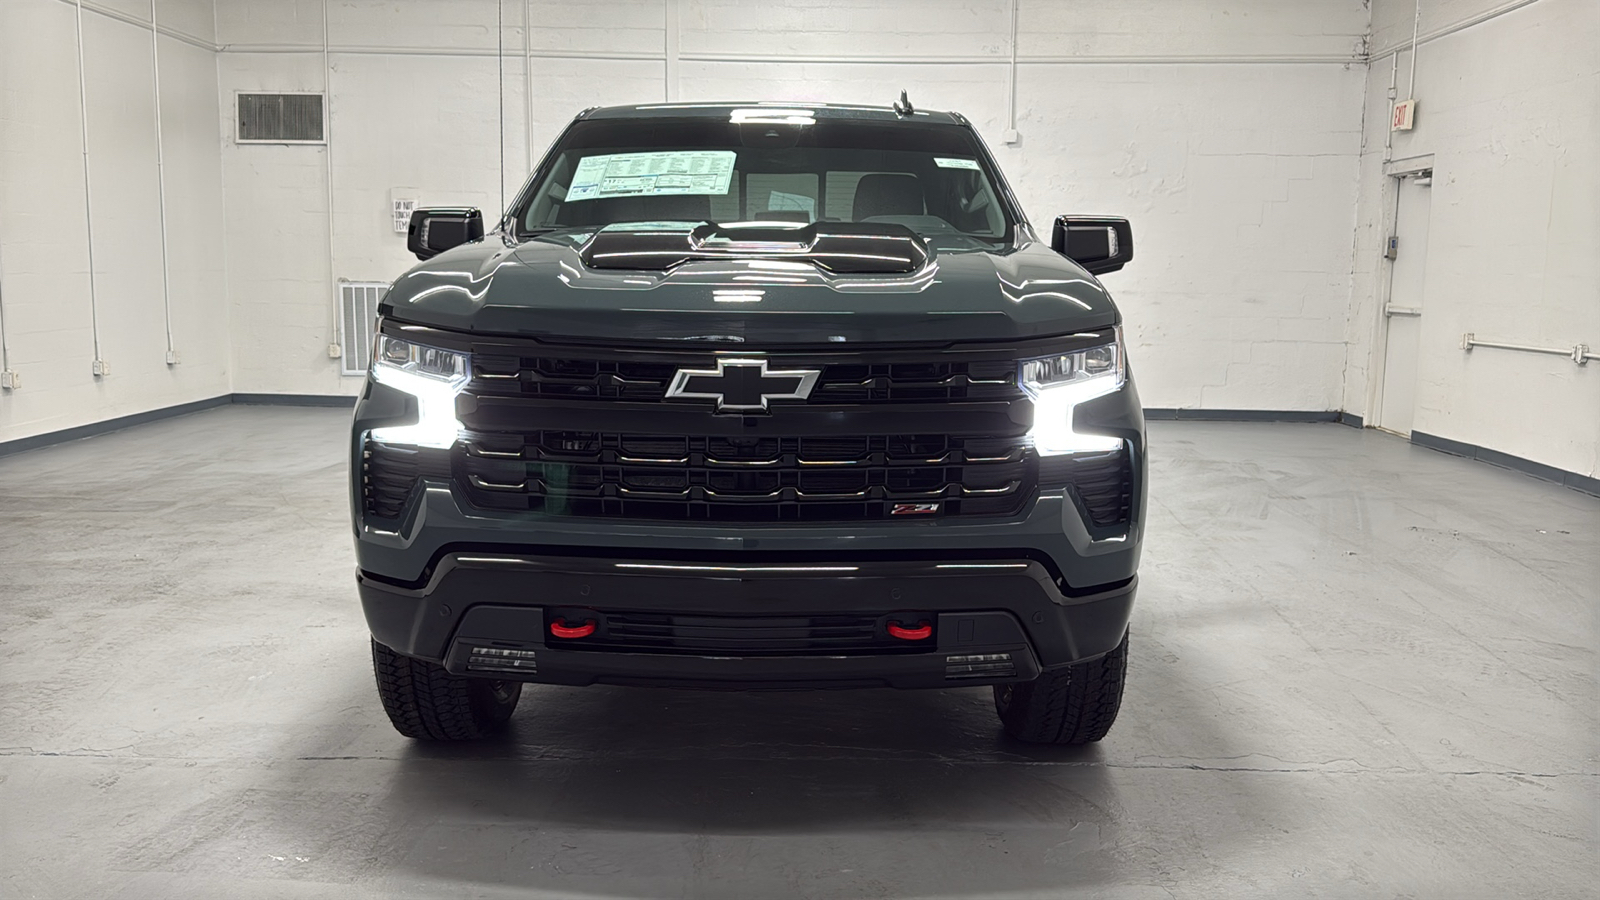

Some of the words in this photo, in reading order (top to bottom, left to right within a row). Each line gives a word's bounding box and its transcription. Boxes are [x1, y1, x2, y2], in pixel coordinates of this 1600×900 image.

[1394, 104, 1407, 127] EXIT
[395, 201, 402, 210] DO
[403, 201, 414, 211] NOT
[395, 220, 410, 231] TEM
